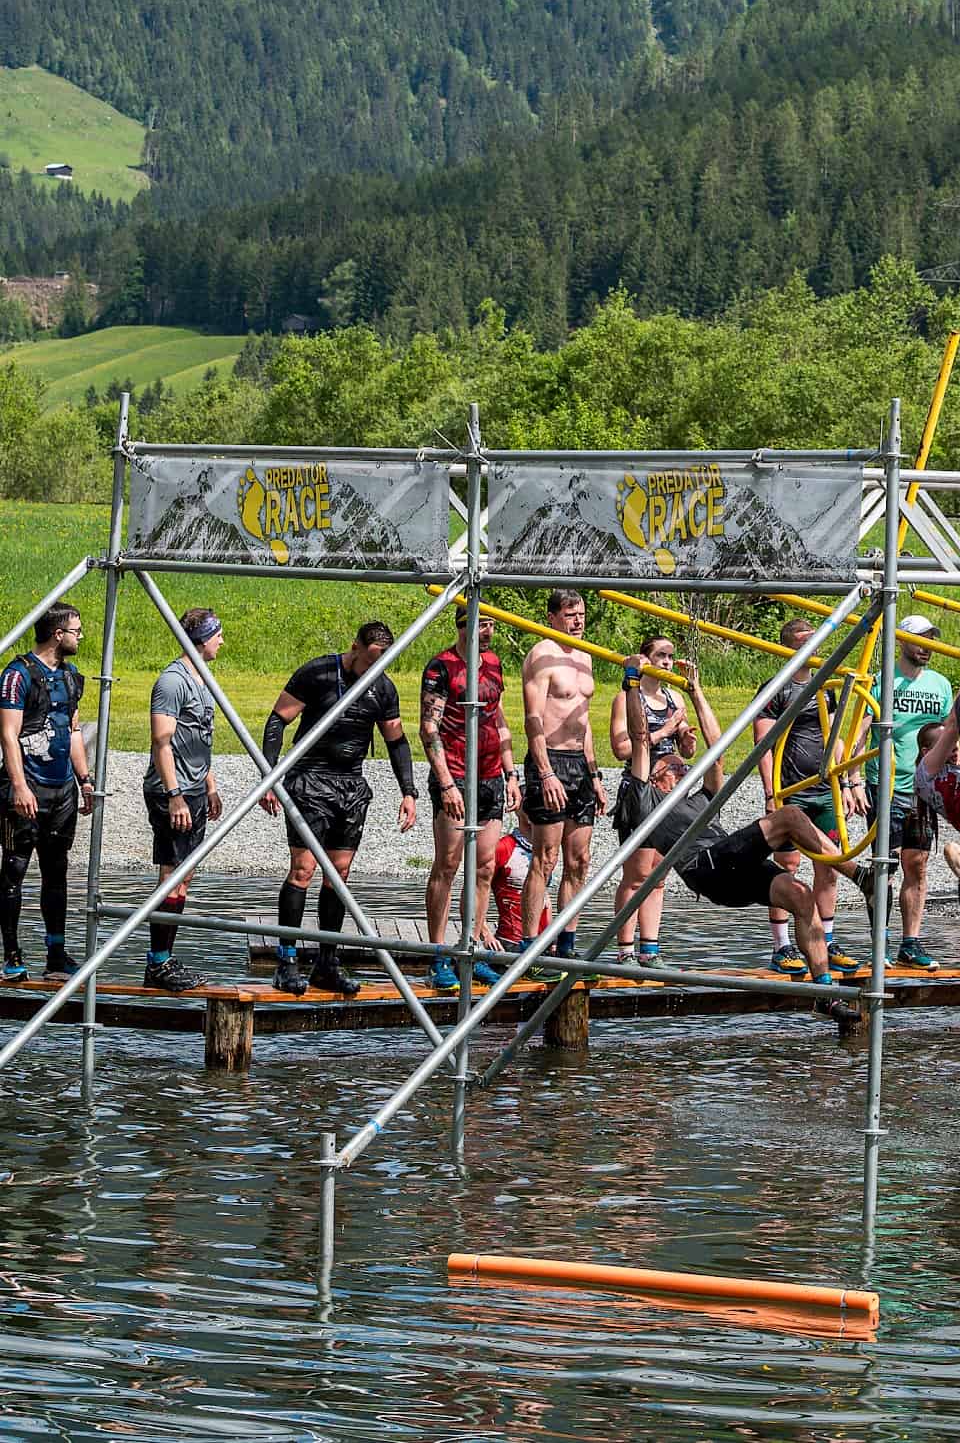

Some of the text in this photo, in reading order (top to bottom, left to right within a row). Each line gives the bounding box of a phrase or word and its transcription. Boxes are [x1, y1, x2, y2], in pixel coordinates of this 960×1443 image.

[265, 462, 328, 490] PREDATOR
[647, 463, 722, 494] PREDATOR
[265, 484, 331, 535] RACE
[648, 487, 724, 543] RACE
[893, 698, 941, 715] ASTARD
